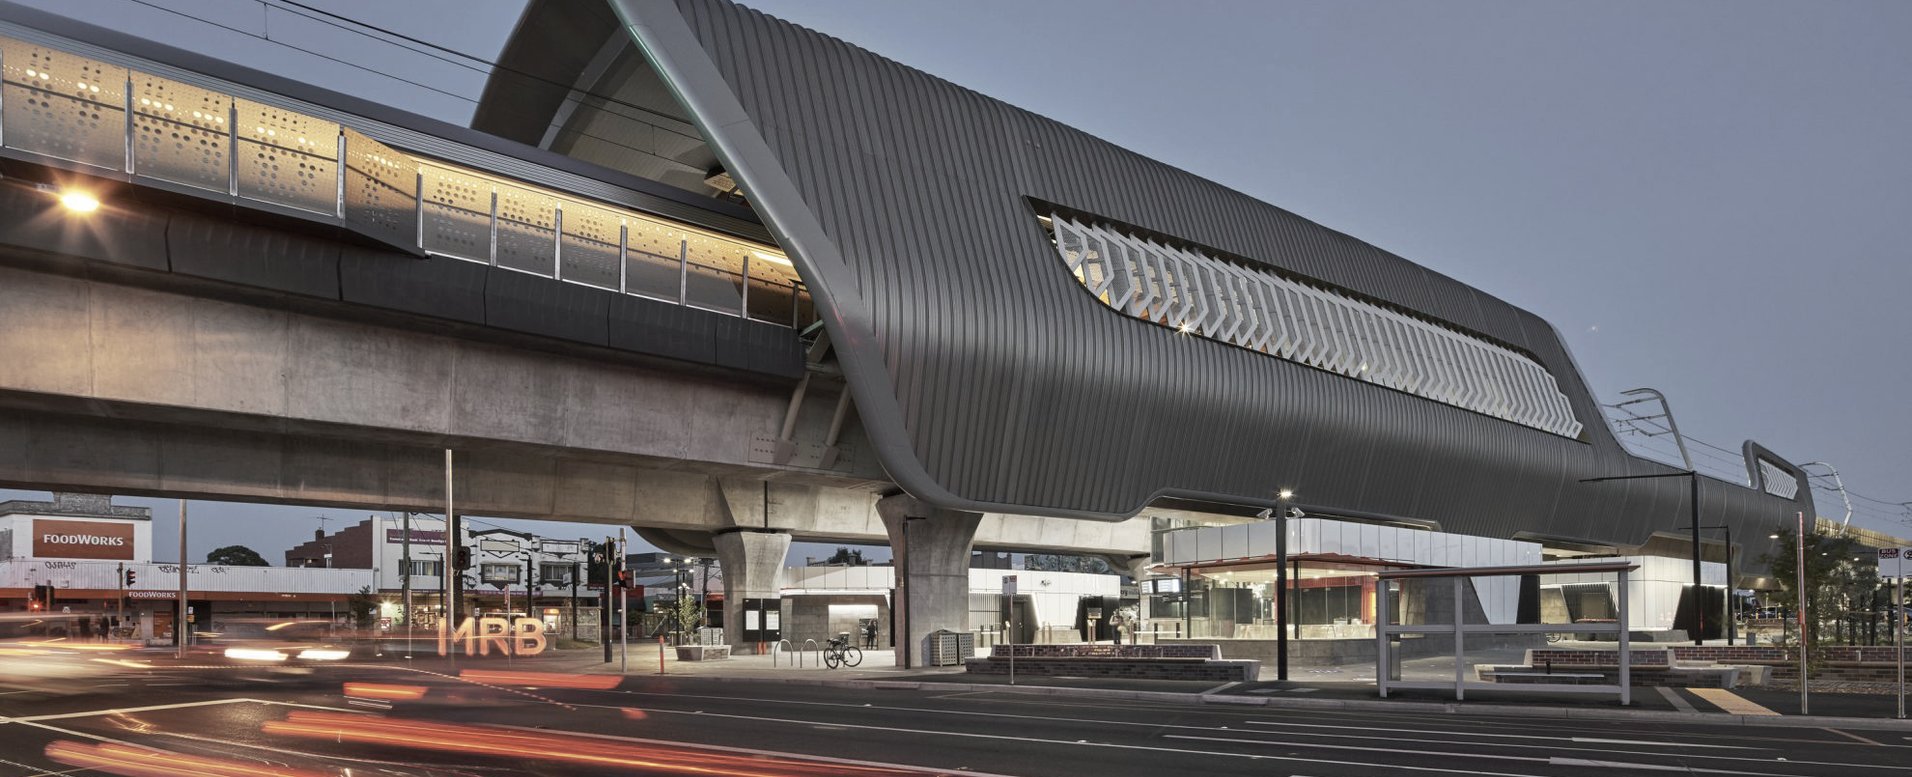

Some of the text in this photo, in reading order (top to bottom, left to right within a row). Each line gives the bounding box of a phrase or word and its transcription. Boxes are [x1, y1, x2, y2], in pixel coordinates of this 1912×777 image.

[43, 534, 124, 546] FOODWORKS
[128, 591, 176, 599] FOODWORKS
[438, 616, 547, 657] MRB
